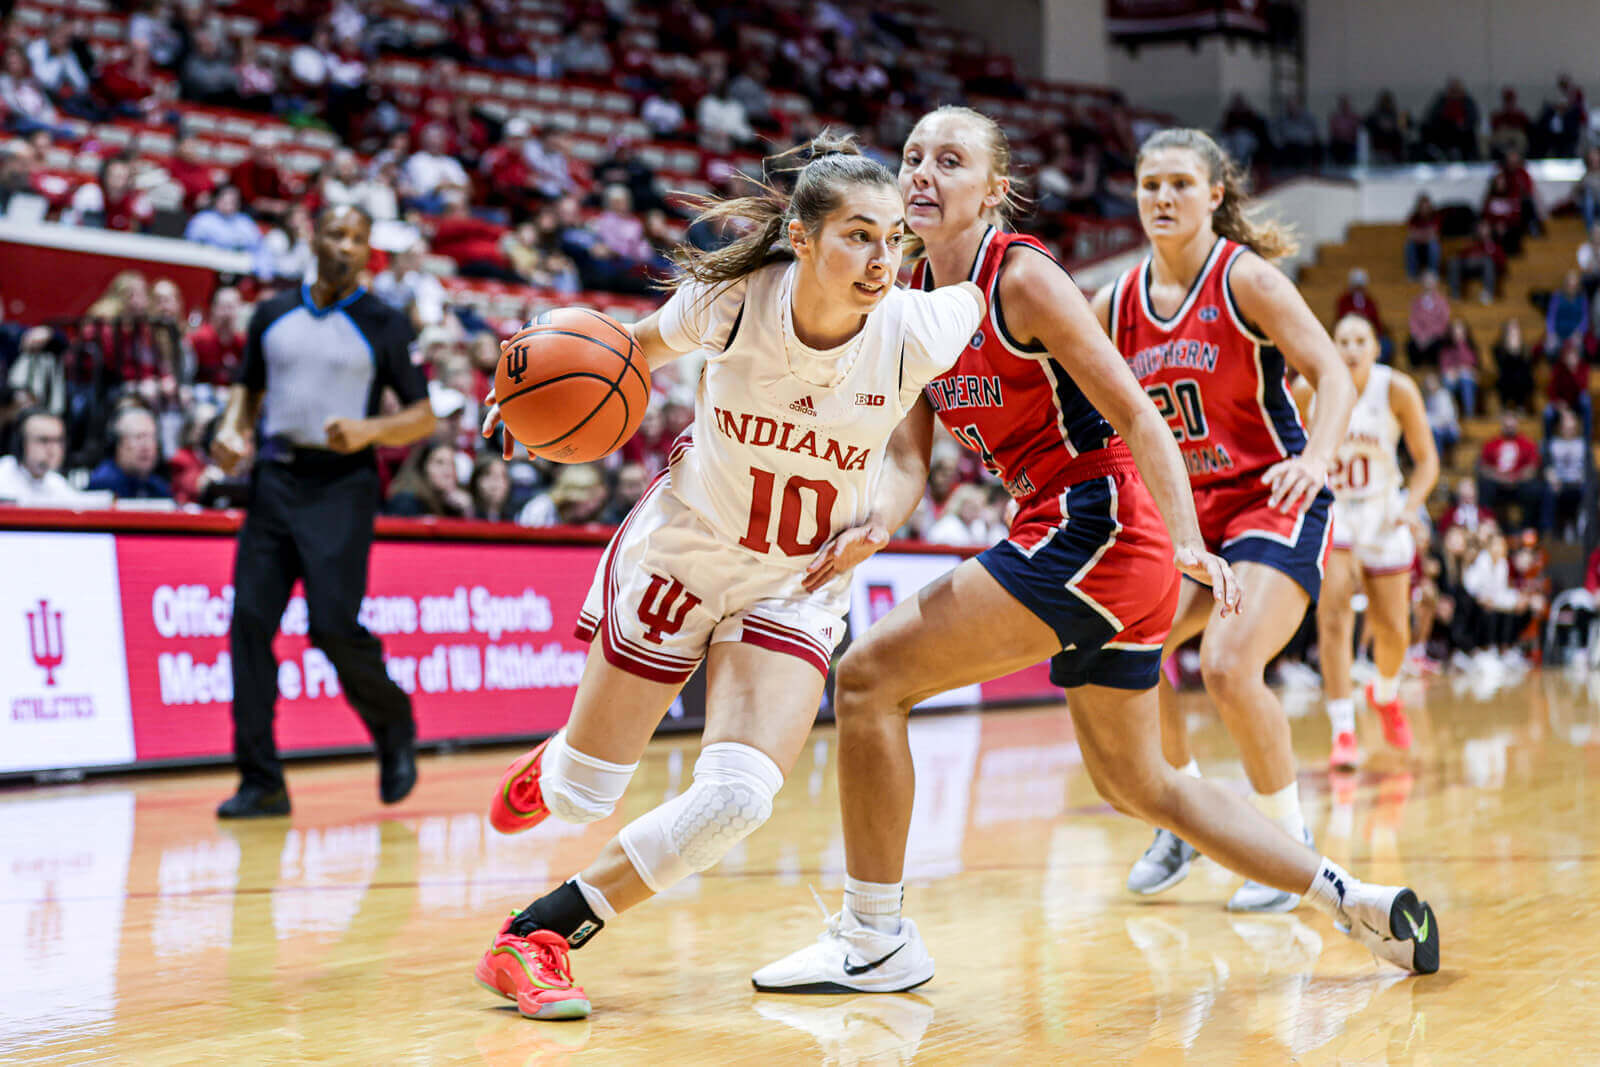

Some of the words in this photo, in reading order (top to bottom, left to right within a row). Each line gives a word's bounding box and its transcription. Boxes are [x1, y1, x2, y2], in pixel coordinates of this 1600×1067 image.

[714, 407, 871, 471] INDIANA
[1144, 379, 1209, 443] 20
[738, 466, 838, 557] 10
[419, 585, 470, 634] and
[470, 585, 553, 641] Sports
[418, 643, 449, 694] of
